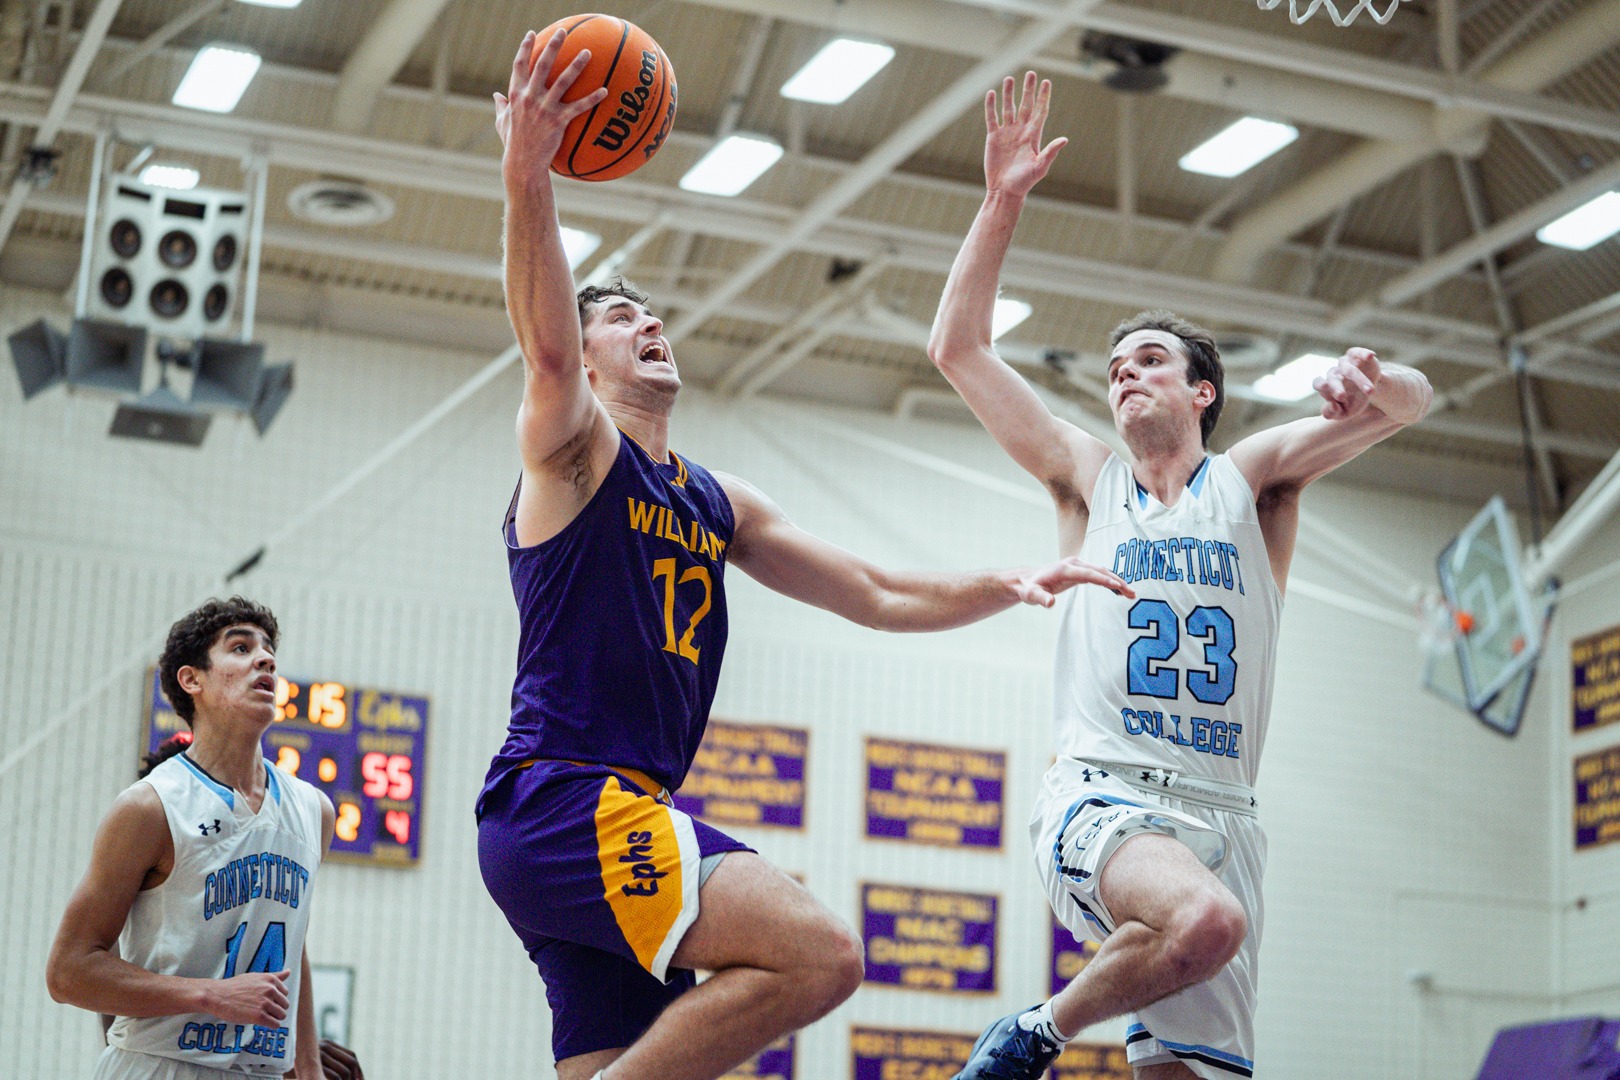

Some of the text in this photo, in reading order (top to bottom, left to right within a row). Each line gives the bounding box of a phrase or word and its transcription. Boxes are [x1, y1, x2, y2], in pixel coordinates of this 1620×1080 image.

[593, 50, 657, 152] Wilson
[652, 557, 713, 666] 12
[1126, 598, 1238, 706] 23
[1121, 707, 1243, 760] COLLEGE
[361, 751, 414, 801] 55
[618, 830, 669, 897] Ephs
[222, 921, 287, 980] 14
[178, 1021, 290, 1059] COLLEGE
